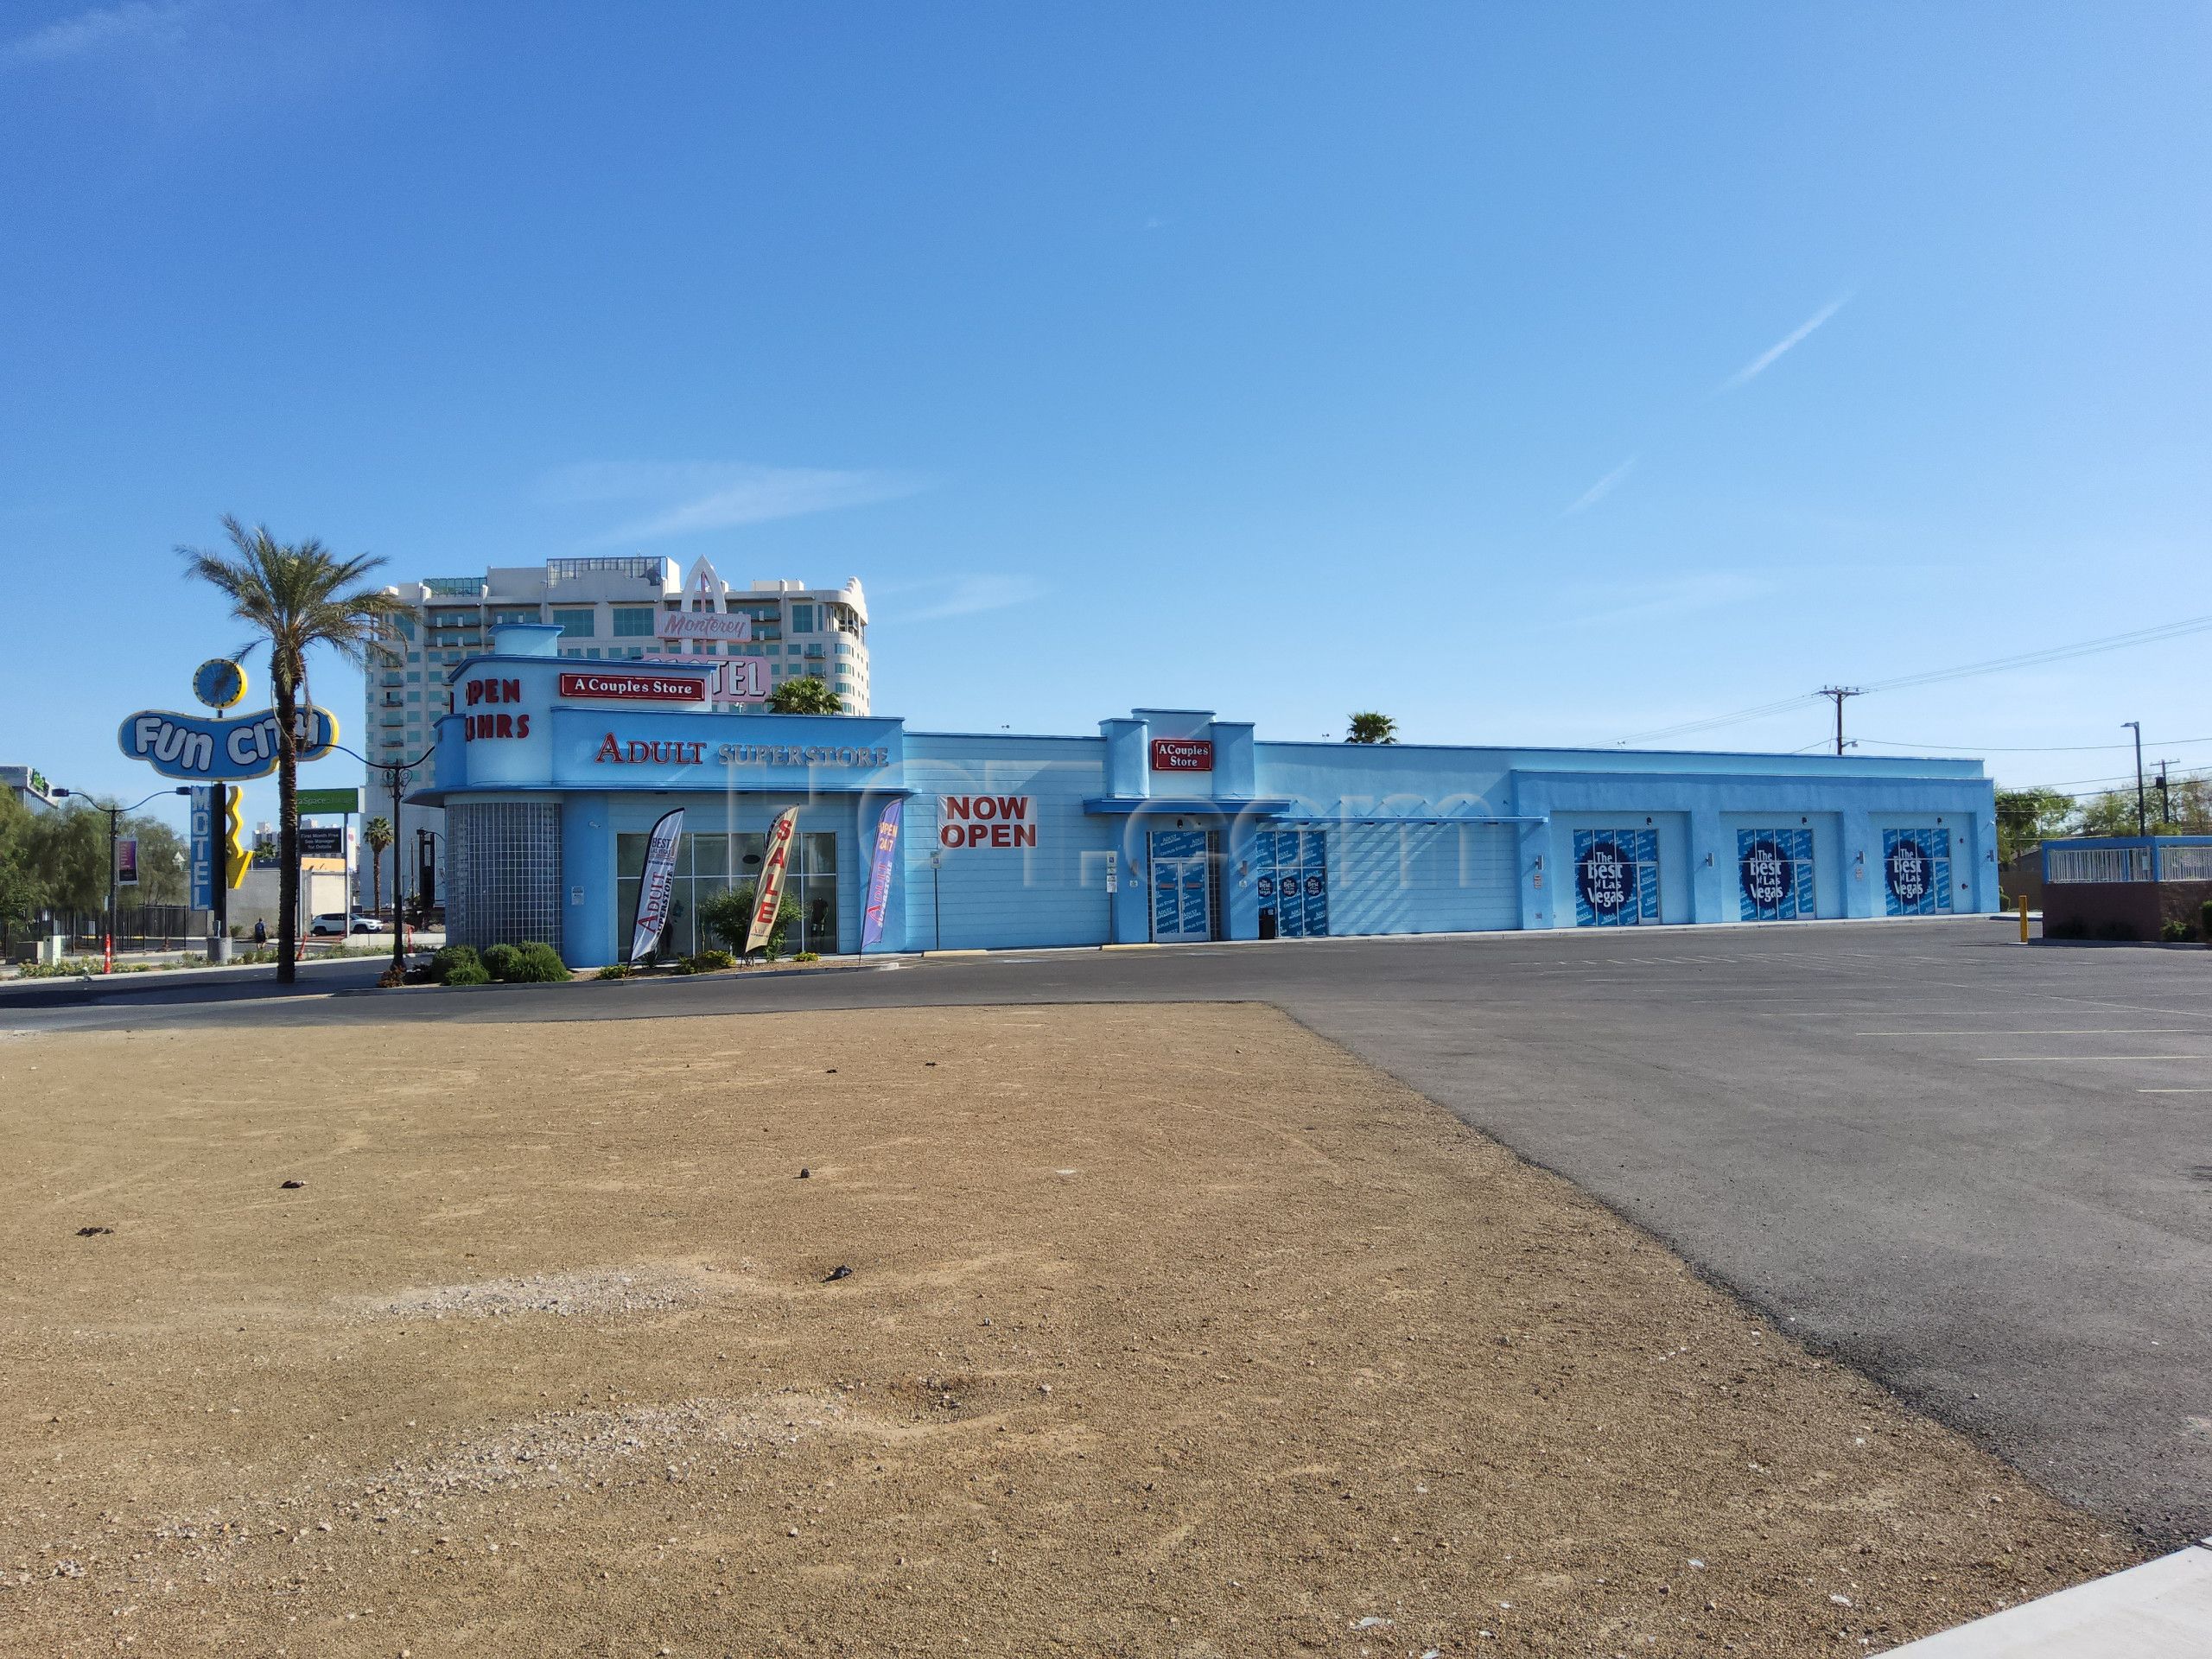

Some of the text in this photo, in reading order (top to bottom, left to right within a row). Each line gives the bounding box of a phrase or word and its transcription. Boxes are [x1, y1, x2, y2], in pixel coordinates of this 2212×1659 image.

[664, 614, 747, 638] Monterey
[466, 679, 520, 706] PEN
[575, 678, 692, 695] A Couples Store
[594, 732, 889, 767] ADULT SUPERSTORE
[1159, 744, 1209, 757] A Couples
[1170, 756, 1198, 766] Store
[947, 797, 1028, 820] NOW
[879, 822, 899, 838] OPEN
[941, 824, 1036, 848] OPEN
[191, 786, 210, 910] MOTEL
[652, 838, 671, 849] BEST
[1596, 851, 1612, 863] The
[1758, 849, 1772, 861] The
[1901, 849, 1914, 859] The
[757, 819, 791, 924] SALE
[1587, 861, 1623, 879] Best
[1750, 858, 1782, 875] Best
[1893, 856, 1923, 873] Best
[1603, 880, 1622, 889] Las
[1764, 876, 1781, 886] Las
[1906, 873, 1921, 882] Las
[1587, 887, 1624, 907] Vegas
[1750, 883, 1783, 902] Vegas
[1894, 880, 1923, 899] Vegas
[637, 872, 664, 933] ADULT
